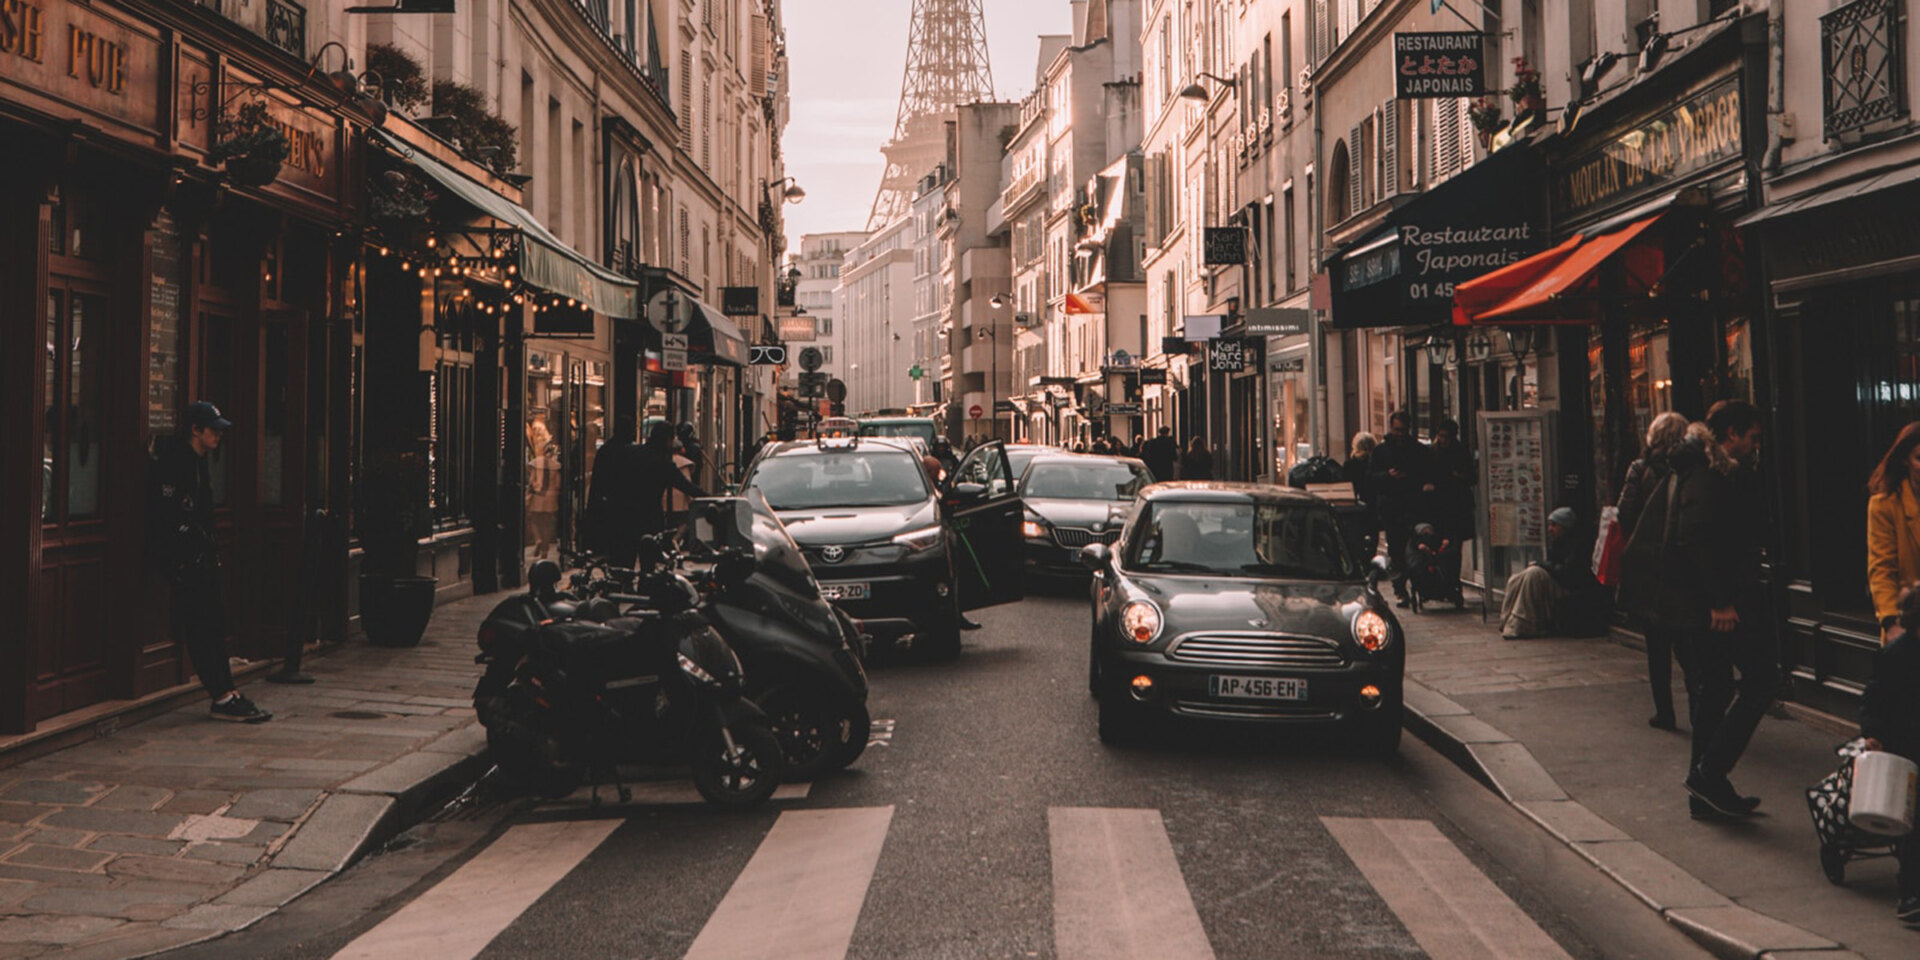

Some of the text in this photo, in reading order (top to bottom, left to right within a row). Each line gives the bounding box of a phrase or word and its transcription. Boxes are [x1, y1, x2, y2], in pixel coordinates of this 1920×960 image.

[1397, 35, 1479, 50] RESTAURANT
[67, 23, 129, 96] PUB
[1400, 56, 1477, 76] とよたか
[1405, 78, 1474, 94] JAPONAIS
[1569, 151, 1621, 209] MOULIN
[1401, 222, 1530, 246] Restaurant
[1416, 248, 1520, 276] Japonais
[1410, 282, 1454, 299] 01 45
[1216, 340, 1242, 351] Karl
[1210, 349, 1242, 361] Marc
[1211, 359, 1242, 371] John
[1220, 678, 1297, 698] AP-456-EH
